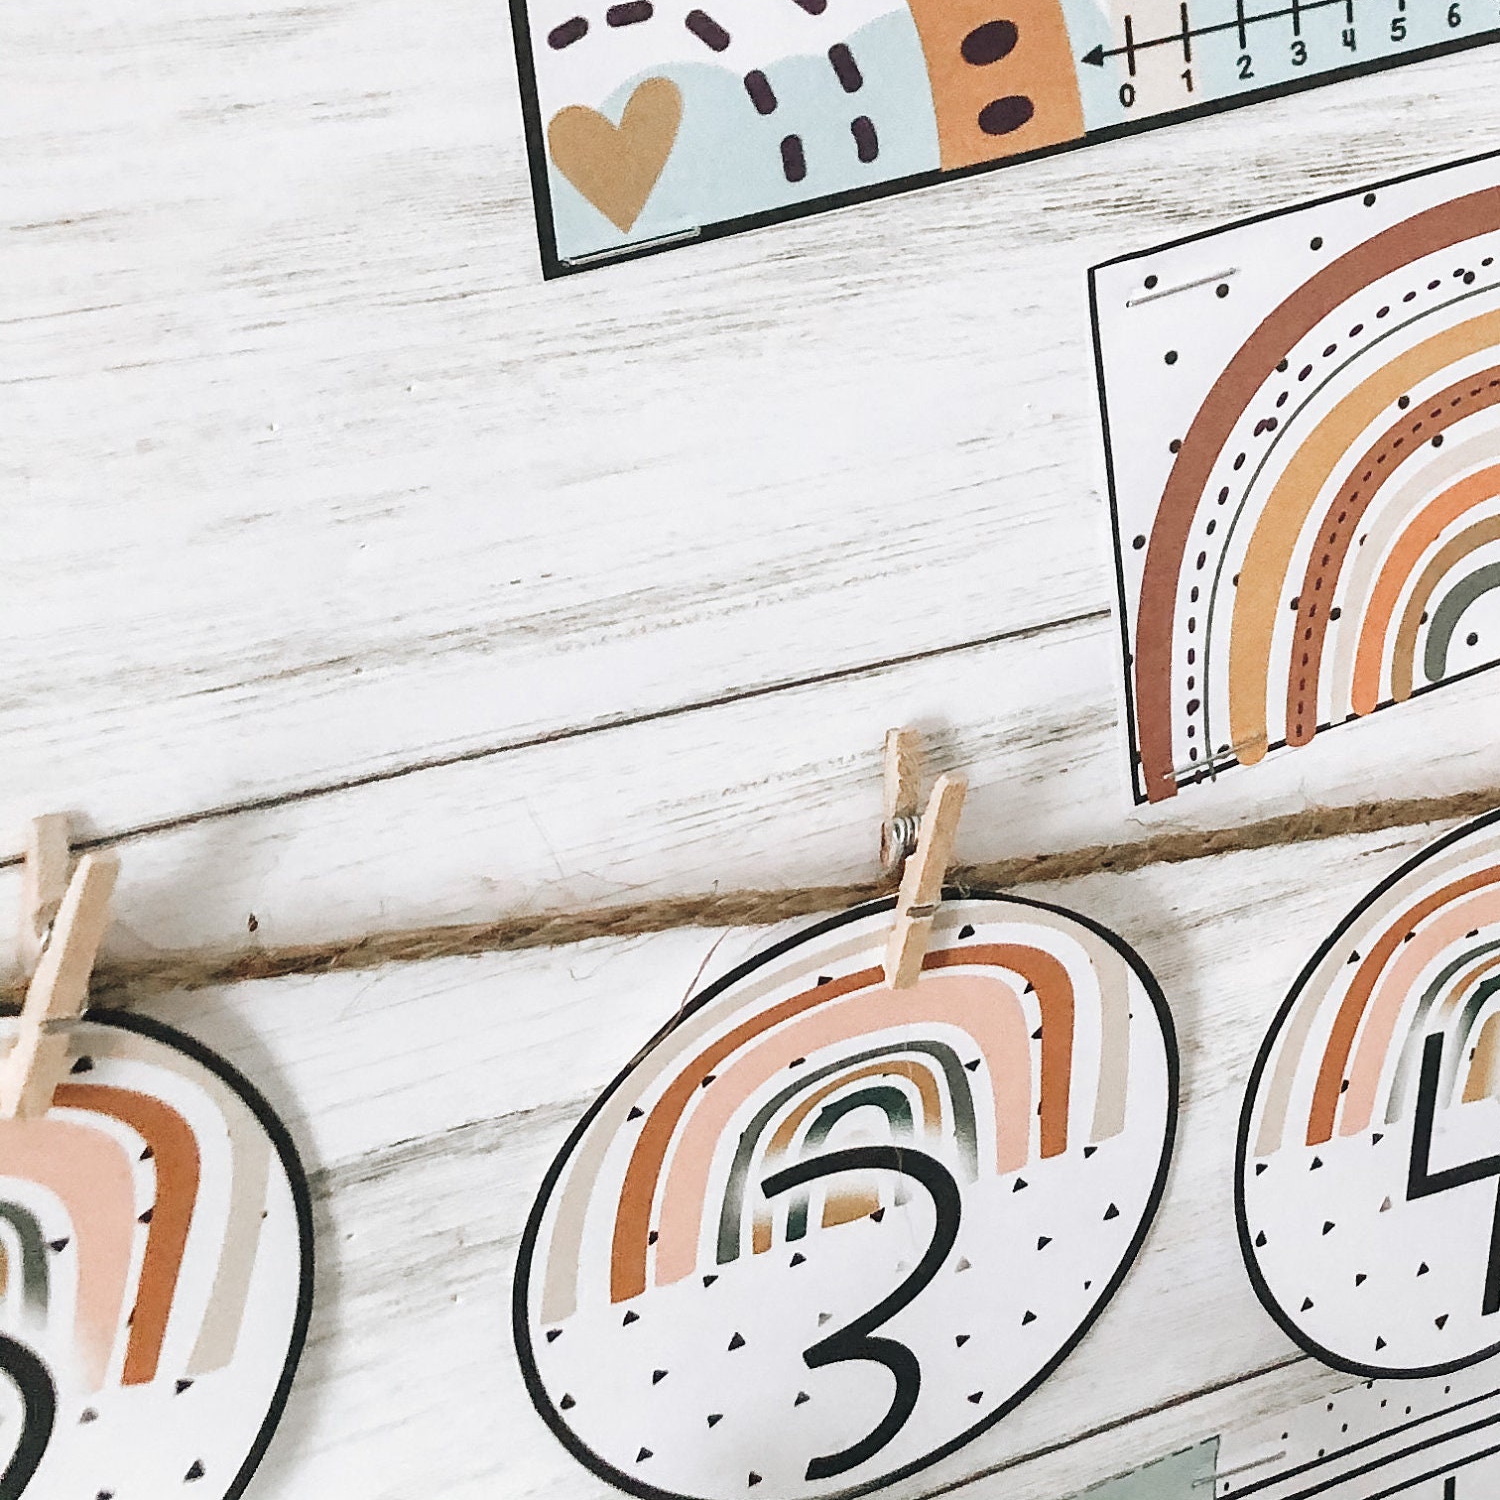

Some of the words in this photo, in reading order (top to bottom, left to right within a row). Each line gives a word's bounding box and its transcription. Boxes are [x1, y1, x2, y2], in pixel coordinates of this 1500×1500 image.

[1118, 82, 1136, 108] 0
[1180, 68, 1194, 93] 1
[1236, 54, 1255, 80] 2
[1290, 40, 1308, 66] 3
[1341, 27, 1357, 52] 4
[1389, 16, 1407, 42] 5
[1447, 2, 1462, 28] 6
[760, 1145, 961, 1482] 3
